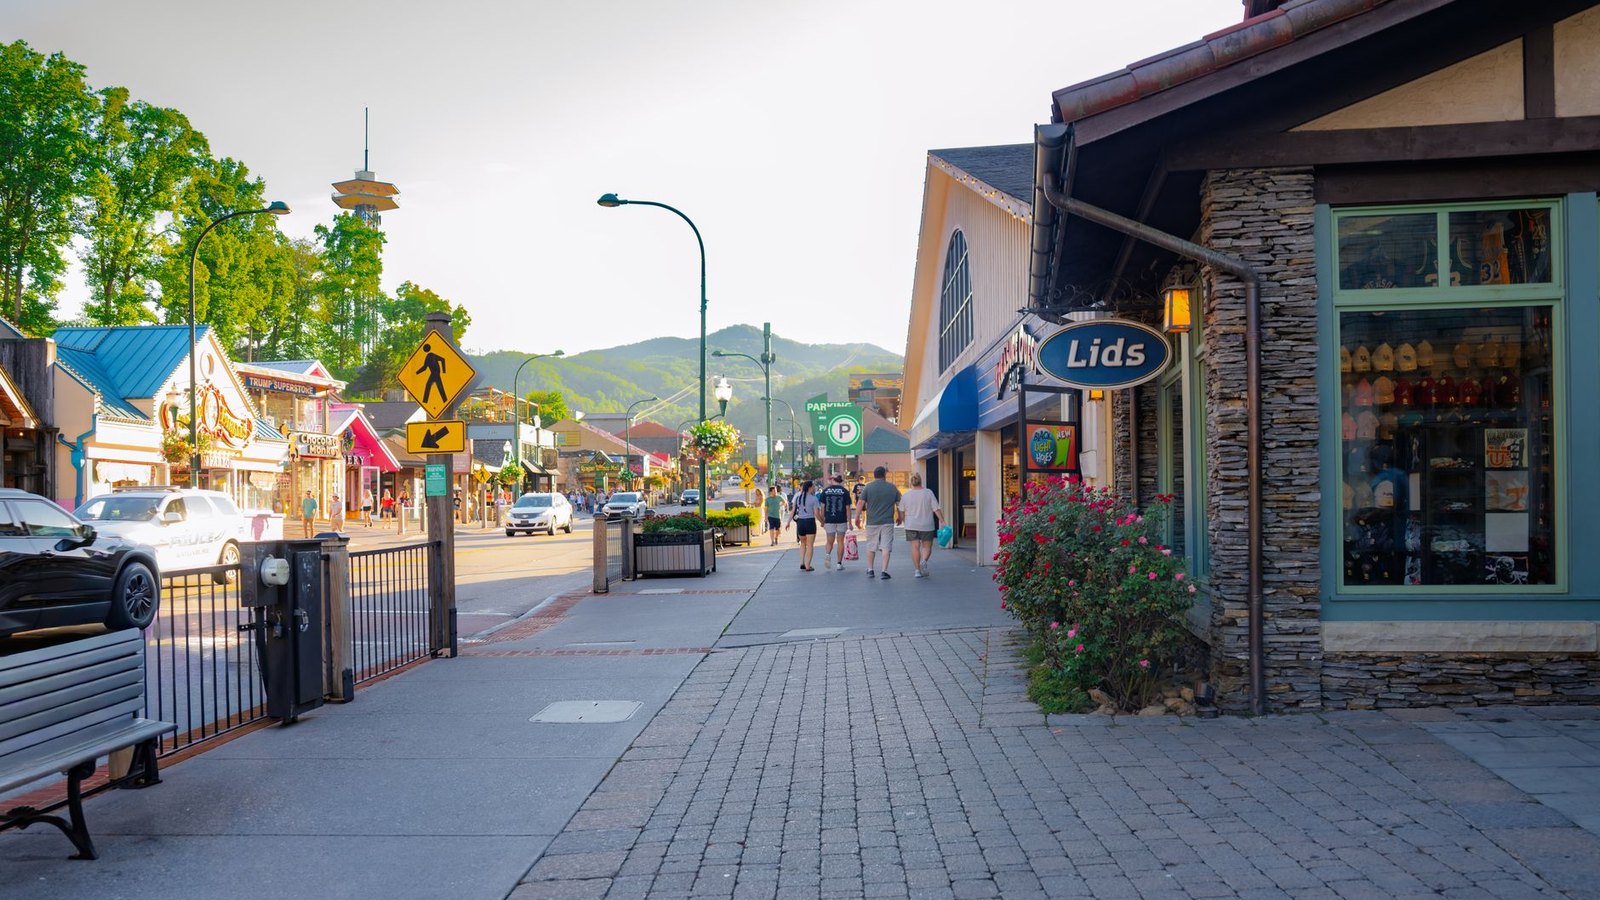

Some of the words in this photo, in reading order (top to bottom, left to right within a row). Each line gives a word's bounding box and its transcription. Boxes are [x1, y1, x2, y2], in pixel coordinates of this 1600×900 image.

[1067, 338, 1146, 369] Lids
[249, 377, 273, 389] TRUMP
[273, 381, 314, 395] SUPERSTORE
[839, 423, 851, 439] P
[1056, 429, 1071, 440] NEW
[310, 445, 340, 457] Monkey
